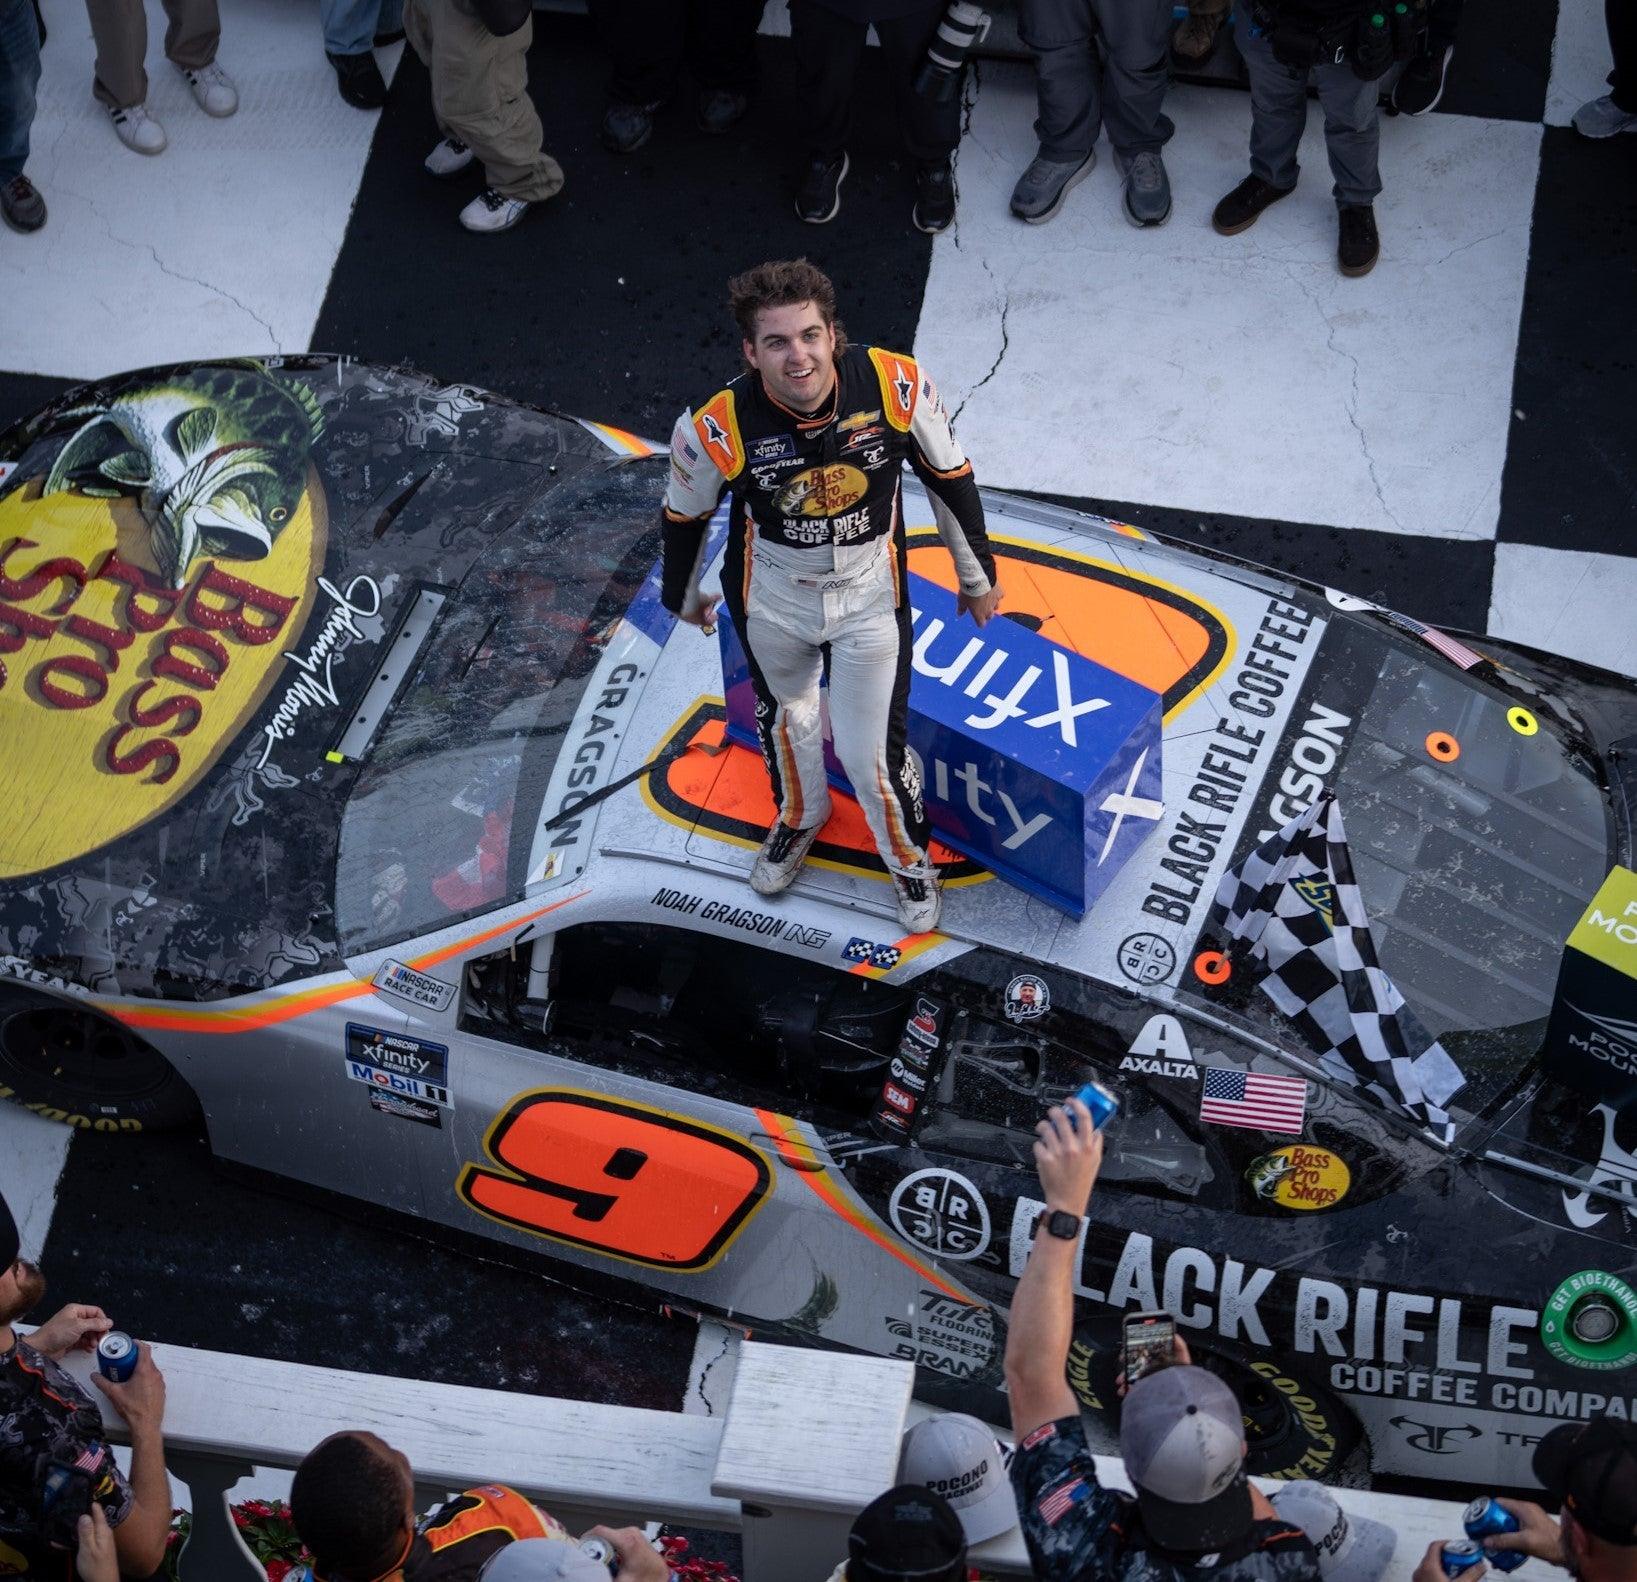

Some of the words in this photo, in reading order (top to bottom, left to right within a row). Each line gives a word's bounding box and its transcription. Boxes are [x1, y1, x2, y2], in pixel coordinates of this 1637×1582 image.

[754, 442, 786, 457] xfinity
[810, 467, 846, 487] Bass
[815, 491, 859, 510] Shops
[37, 551, 190, 710] Pro
[106, 561, 300, 786] Bass
[906, 608, 1111, 748] xfin
[557, 662, 639, 848] GRAGSON
[1141, 817, 1227, 926] BLACK
[1189, 718, 1267, 818] RIFLE
[1228, 600, 1318, 719] COFFEE
[650, 887, 703, 915] NOAH
[700, 901, 787, 938] GRAGSON
[384, 977, 411, 995] RACE
[414, 990, 438, 1005] CAR
[401, 972, 444, 996] NASCAR
[362, 1043, 430, 1074] xfinity
[384, 1036, 420, 1052] NASCAR
[351, 1063, 419, 1096] Mobil
[382, 1061, 411, 1074] SERIES
[1118, 1056, 1200, 1080] AXALTA
[1291, 1148, 1330, 1169] Bass
[457, 1086, 775, 1273] 9
[1289, 1166, 1320, 1186] Pro
[1287, 1180, 1339, 1204] Shops
[919, 1290, 992, 1329] Tufc
[1551, 1288, 1571, 1312] GET
[1294, 1278, 1539, 1380] RIFLE
[1331, 1362, 1479, 1406] COFFEE
[926, 1459, 989, 1495] POCONO
